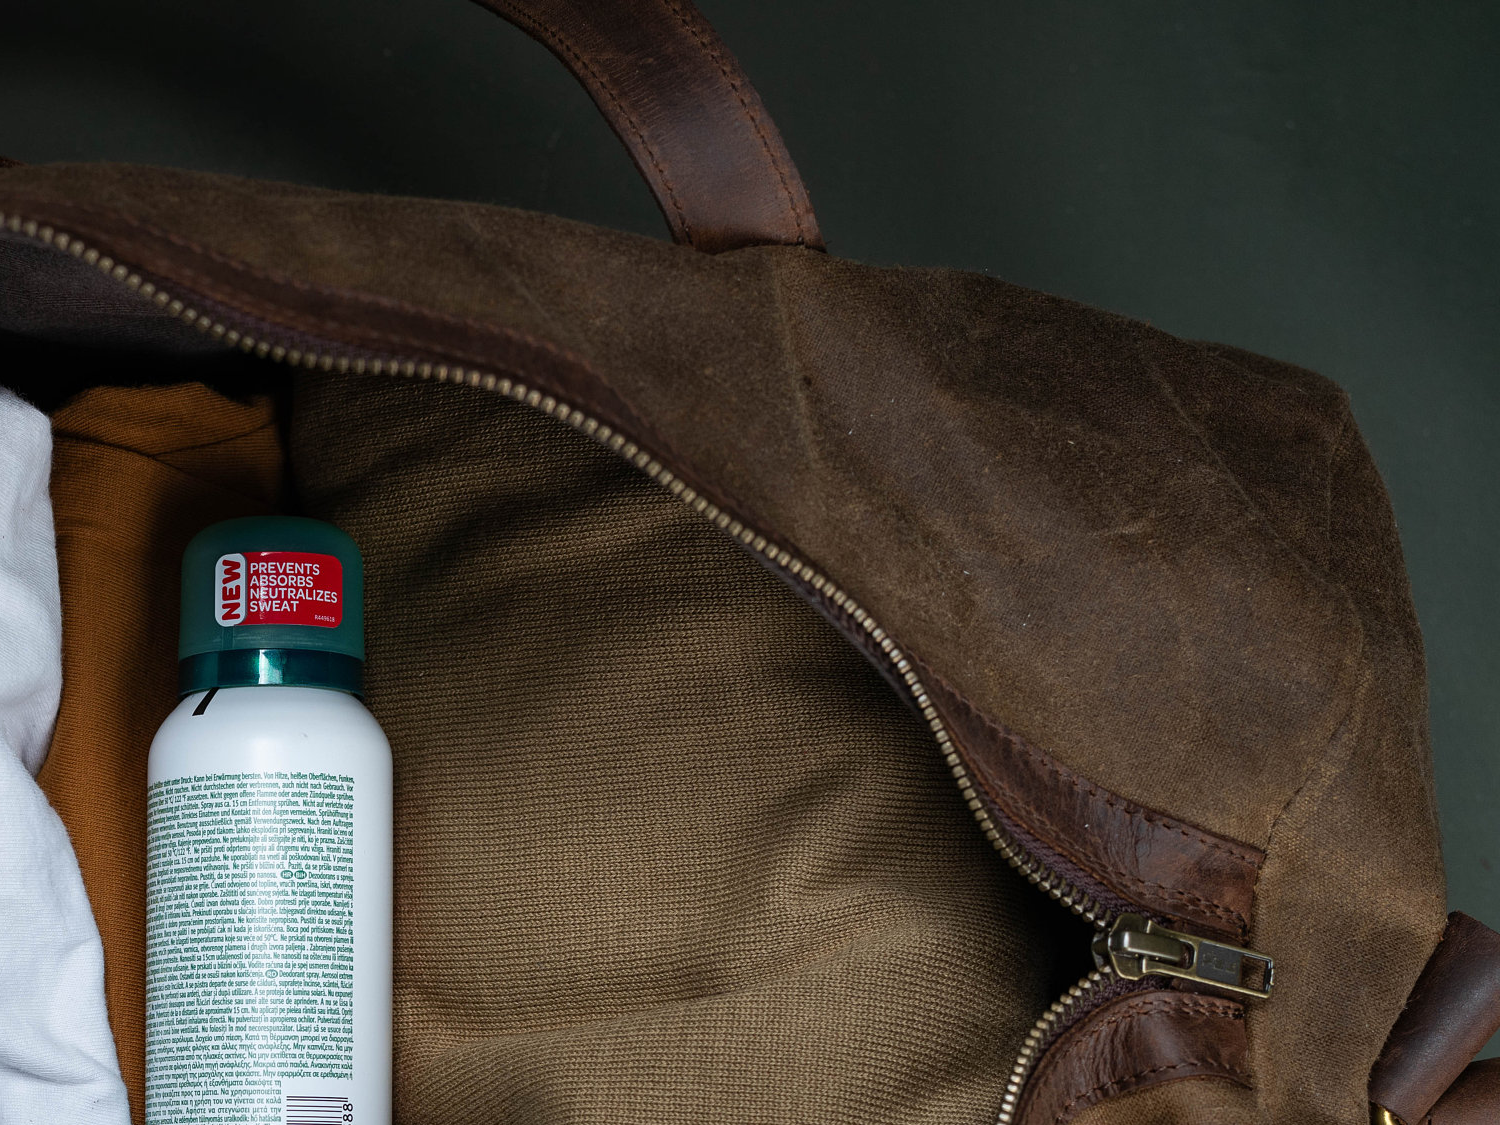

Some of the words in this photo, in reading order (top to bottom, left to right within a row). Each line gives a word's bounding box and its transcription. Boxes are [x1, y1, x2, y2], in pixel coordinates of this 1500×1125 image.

[250, 562, 320, 576] PREVENTS
[250, 575, 314, 588] ABSORBS
[222, 560, 241, 621] NEW
[250, 587, 338, 604] NEUTRALIZES
[250, 600, 300, 613] SWEAT
